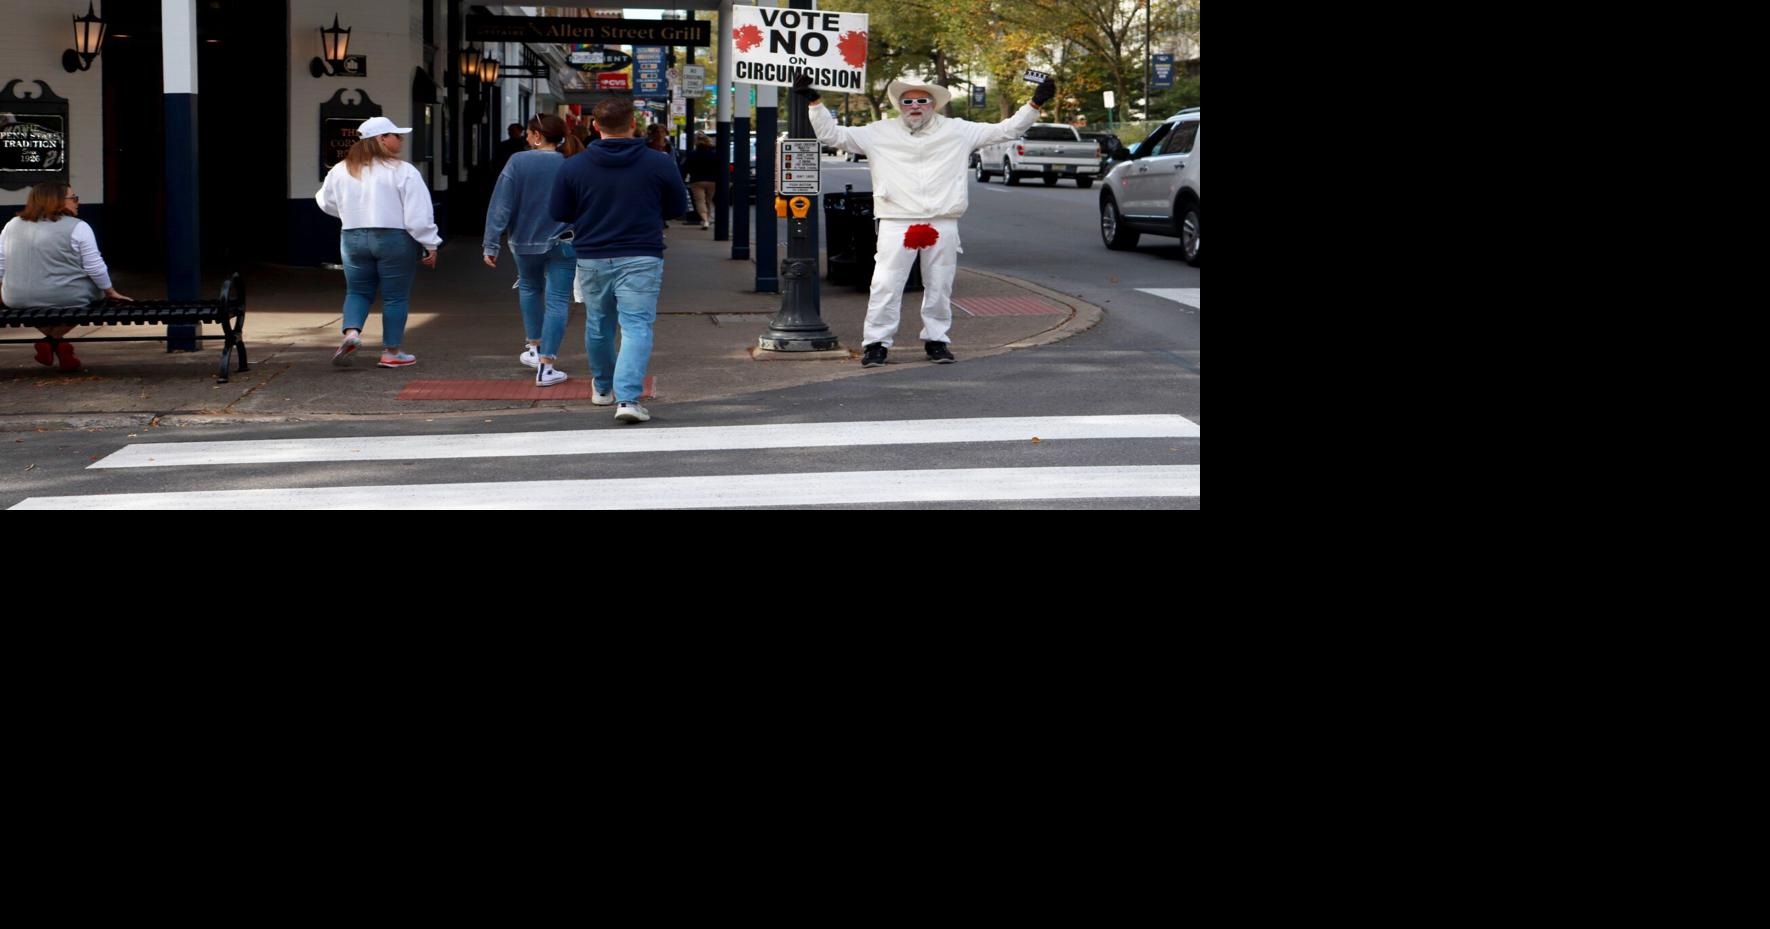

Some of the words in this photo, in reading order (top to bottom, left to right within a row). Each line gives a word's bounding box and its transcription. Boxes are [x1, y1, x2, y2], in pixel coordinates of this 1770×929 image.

[759, 9, 840, 32] VOTE
[546, 23, 595, 38] Allen
[600, 25, 655, 40] Street
[660, 26, 701, 41] Grill
[769, 29, 829, 57] NO
[789, 56, 807, 66] ON
[736, 60, 861, 90] CIRCUMCISION
[0, 131, 27, 139] PENN
[3, 140, 57, 148] TRADITION
